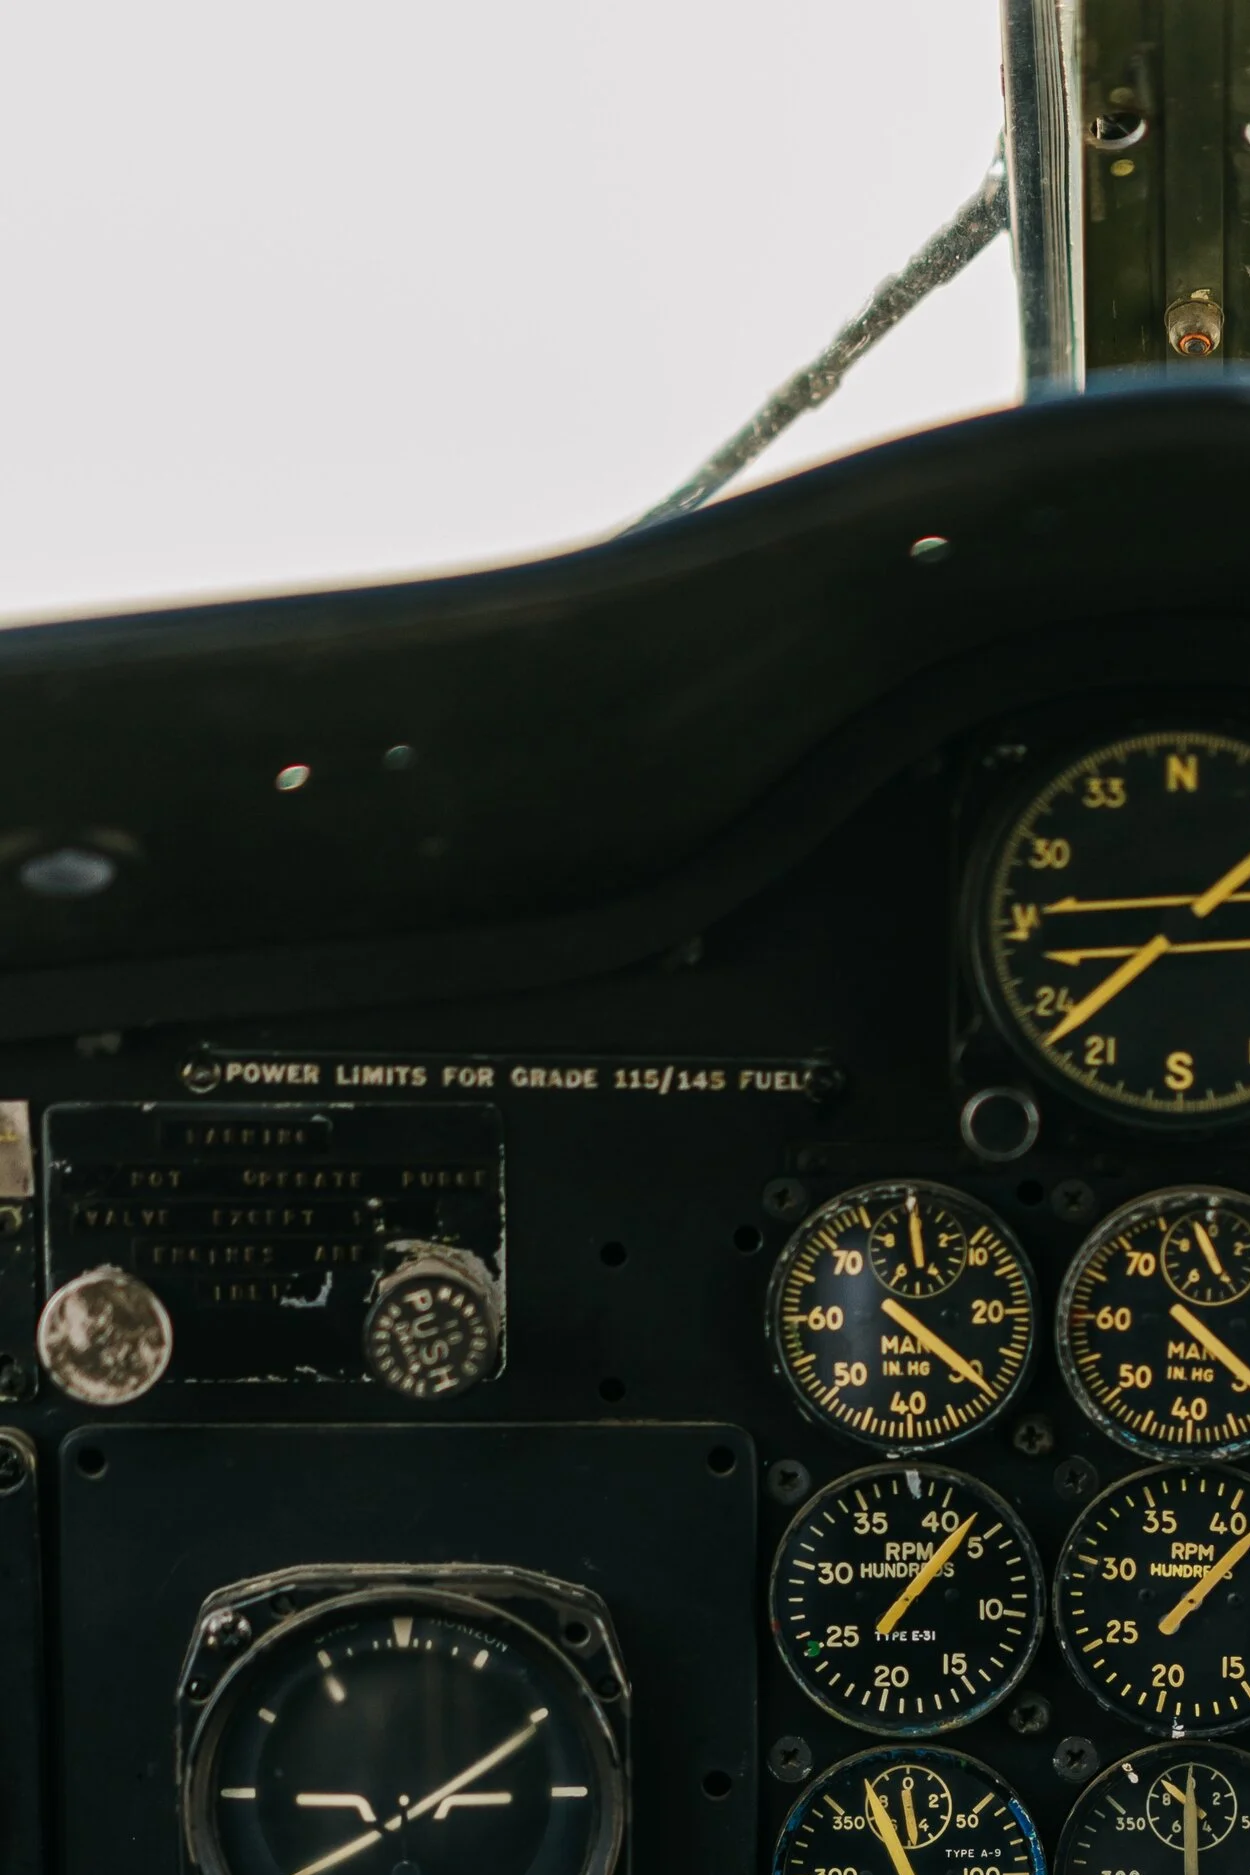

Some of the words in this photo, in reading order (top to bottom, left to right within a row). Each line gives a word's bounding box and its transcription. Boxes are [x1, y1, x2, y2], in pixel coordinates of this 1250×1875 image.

[1167, 755, 1198, 793] N
[1083, 778, 1126, 807] 33
[1030, 839, 1070, 869] 30
[1085, 1037, 1116, 1065] 21
[226, 1062, 320, 1084] POWER
[337, 1066, 427, 1086] LIMITS
[442, 1067, 494, 1087] FOR
[510, 1067, 598, 1089] GRADE
[613, 1066, 726, 1095] 115/145
[738, 1069, 807, 1091] FUEL
[1165, 1053, 1193, 1090] S
[832, 1250, 863, 1275] 70
[808, 1305, 844, 1331] 60
[971, 1300, 1004, 1324] 20
[1096, 1306, 1132, 1331] 60
[834, 1362, 867, 1386] 50
[907, 1361, 930, 1376] HG
[1192, 1367, 1214, 1382] HG
[890, 1391, 926, 1414] 40
[1171, 1397, 1208, 1421] 40
[854, 1512, 888, 1534] 35
[921, 1511, 959, 1532] 40
[1142, 1510, 1177, 1534] 35
[1209, 1512, 1248, 1535] 40
[885, 1542, 933, 1561] RPM
[1171, 1543, 1215, 1561] RPM
[818, 1562, 853, 1585] 30
[827, 1626, 859, 1647] 25
[943, 1653, 967, 1675] 15
[1152, 1664, 1184, 1687] 20
[874, 1666, 909, 1687] 20
[833, 1816, 865, 1831] 350
[946, 1849, 975, 1858] TYPE
[981, 1849, 1001, 1857] A-9
